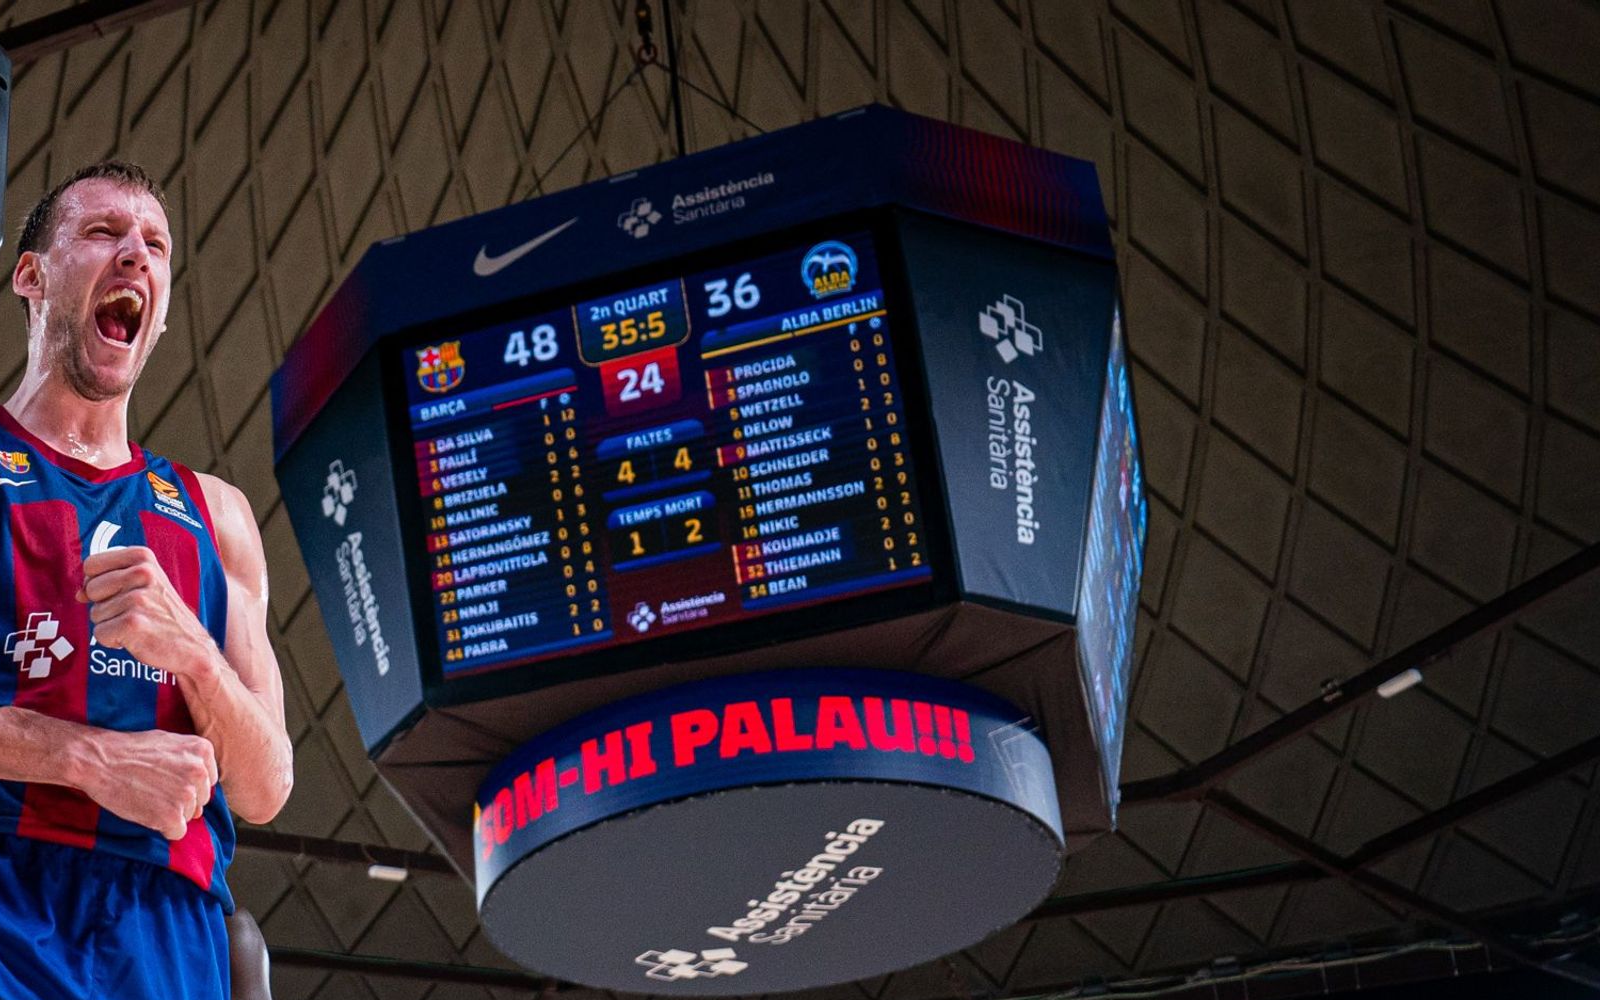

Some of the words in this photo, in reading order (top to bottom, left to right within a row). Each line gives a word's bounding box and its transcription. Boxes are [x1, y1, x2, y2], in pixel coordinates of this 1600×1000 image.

[672, 172, 775, 209] Assistència
[672, 195, 746, 225] Sanitària
[590, 306, 611, 322] 2n
[613, 288, 669, 316] QUART
[704, 272, 761, 318] 36
[781, 310, 820, 332] ALBA
[822, 295, 878, 321] BERLIN
[504, 324, 559, 366] 48
[601, 311, 666, 350] 35:5
[733, 354, 796, 381] PROCIDA
[850, 338, 861, 353] 0
[873, 333, 883, 347] 0
[617, 362, 665, 402] 24
[736, 371, 810, 399] SPAGNOLO
[853, 357, 864, 372] 0
[740, 393, 804, 419] WETZELL
[857, 377, 866, 391] 1
[880, 372, 890, 386] 0
[420, 398, 466, 421] BARÇA
[743, 415, 793, 438] DELOW
[860, 397, 871, 411] 2
[883, 391, 893, 406] 2
[436, 436, 456, 453] DA
[457, 428, 494, 448] SILVA
[545, 432, 554, 446] 0
[566, 428, 575, 441] 0
[626, 428, 673, 450] FALTES
[746, 426, 833, 458] MATTISSECK
[865, 417, 873, 430] 1
[886, 412, 897, 426] 0
[986, 375, 1013, 490] Sanitària
[441, 467, 488, 489] VESELY
[547, 451, 557, 464] 0
[617, 460, 636, 484] 4
[674, 447, 692, 471] 4
[733, 466, 748, 481] 10
[749, 448, 830, 478] SCHNEIDER
[867, 437, 878, 451] 0
[752, 471, 813, 497] THOMAS
[870, 457, 880, 471] 0
[1012, 380, 1041, 545] Assistència
[443, 482, 507, 508] BRIZUELA
[550, 469, 559, 483] 2
[571, 464, 580, 478] 2
[755, 480, 865, 517] HERMANNSSON
[873, 476, 884, 490] 2
[446, 503, 499, 526] KALINIC
[552, 488, 562, 502] 0
[618, 504, 662, 526] TEMPS
[665, 496, 703, 516] MORT
[758, 515, 799, 536] NIKIC
[877, 496, 887, 510] 0
[900, 491, 910, 505] 2
[449, 516, 532, 546] SATORANSKY
[451, 531, 550, 564] HERNANGÓMEZ
[558, 527, 568, 541] 0
[629, 531, 645, 556] 1
[684, 518, 704, 543] 2
[762, 526, 841, 556] KOUMADJE
[880, 516, 890, 531] 2
[904, 511, 914, 525] 0
[453, 551, 548, 583] LAPROVITTOLA
[561, 545, 571, 560] 0
[764, 547, 842, 576] THIEMANN
[883, 536, 894, 551] 0
[907, 531, 917, 546] 2
[456, 579, 507, 599] PARKER
[563, 564, 573, 578] 0
[768, 575, 807, 596] BEAN
[888, 557, 897, 571] 1
[911, 552, 921, 566] 2
[348, 531, 390, 676] Assistència
[459, 601, 499, 620] NNAJI
[566, 584, 576, 598] 0
[587, 578, 597, 593] 0
[461, 612, 538, 640] JOKUBAITIS
[569, 603, 579, 617] 2
[591, 598, 600, 612] 2
[464, 639, 508, 658] PARRA
[593, 618, 603, 631] 0
[90, 650, 176, 686] Sanitàr
[479, 721, 657, 861] SOM-HI
[670, 695, 976, 767] PALAU!!!
[707, 816, 886, 943] Assistència
[748, 864, 884, 946] Sanitària
